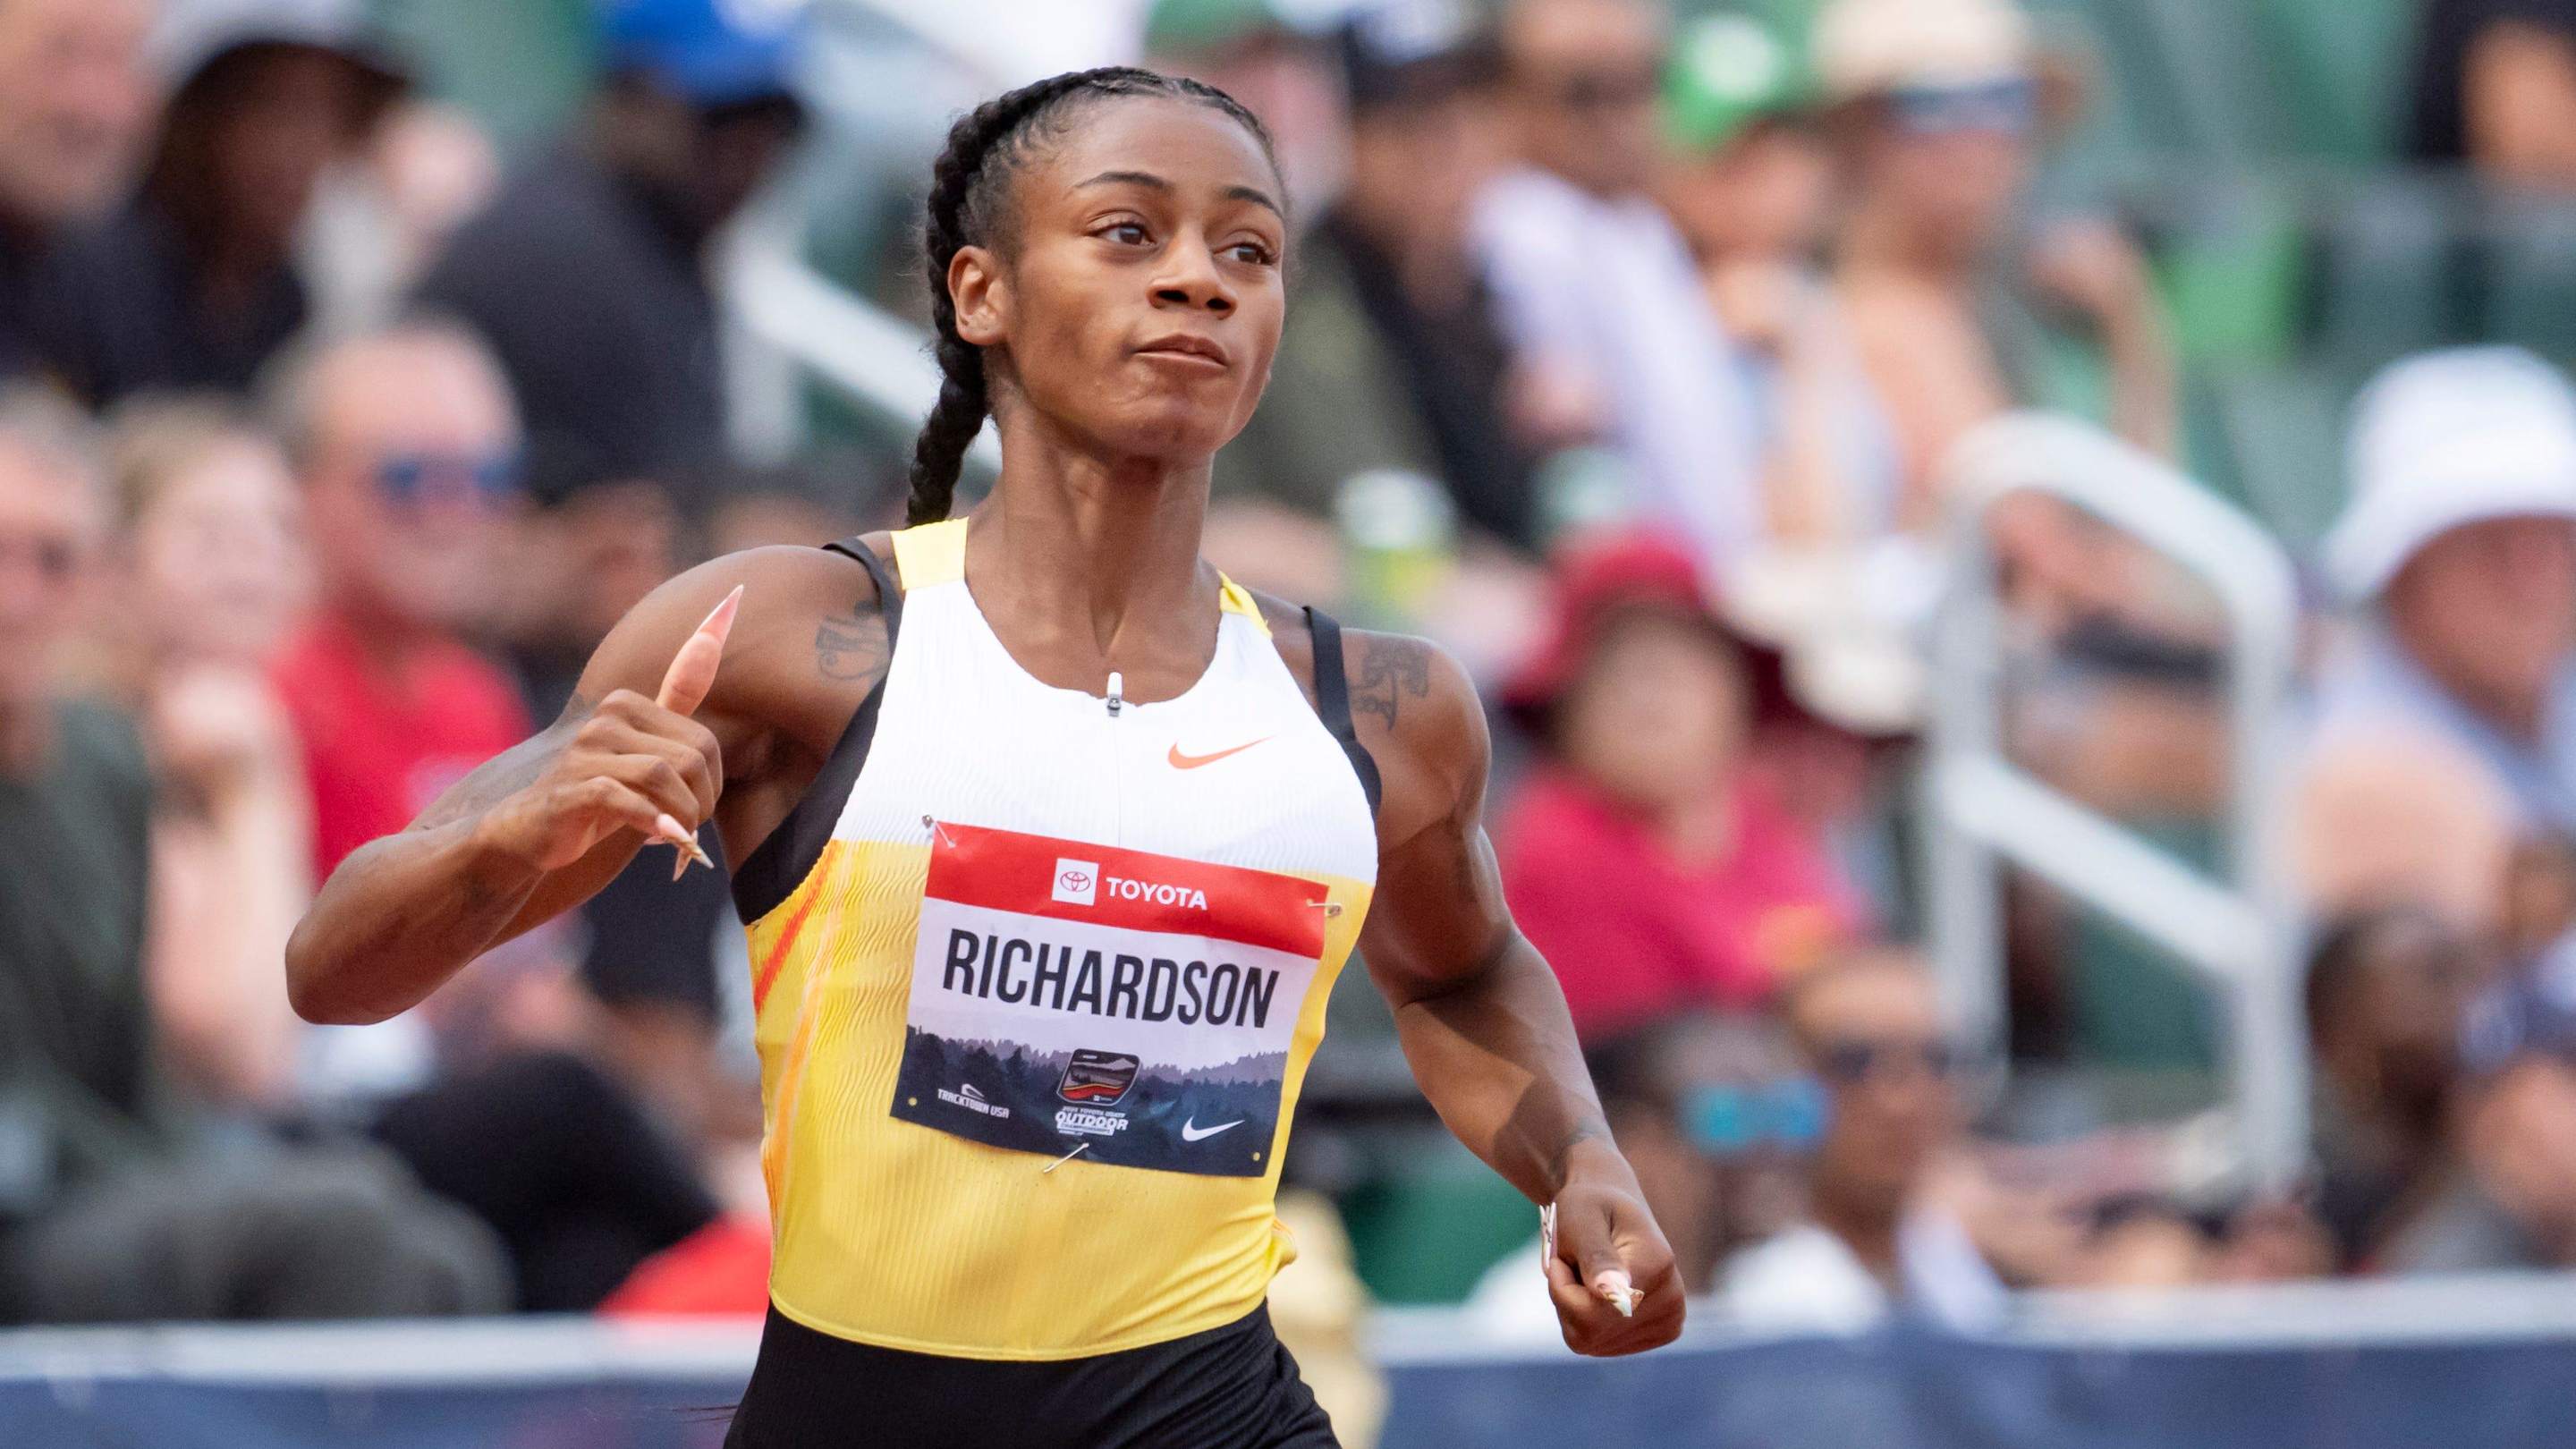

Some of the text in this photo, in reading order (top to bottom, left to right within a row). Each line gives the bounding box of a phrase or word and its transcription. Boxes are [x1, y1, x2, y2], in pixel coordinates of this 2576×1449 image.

[1105, 877, 1208, 911] TOYOTA
[942, 928, 1280, 1029] RICHARDSON
[990, 1106, 1010, 1119] USA
[1055, 1111, 1129, 1131] OUTDOOR
